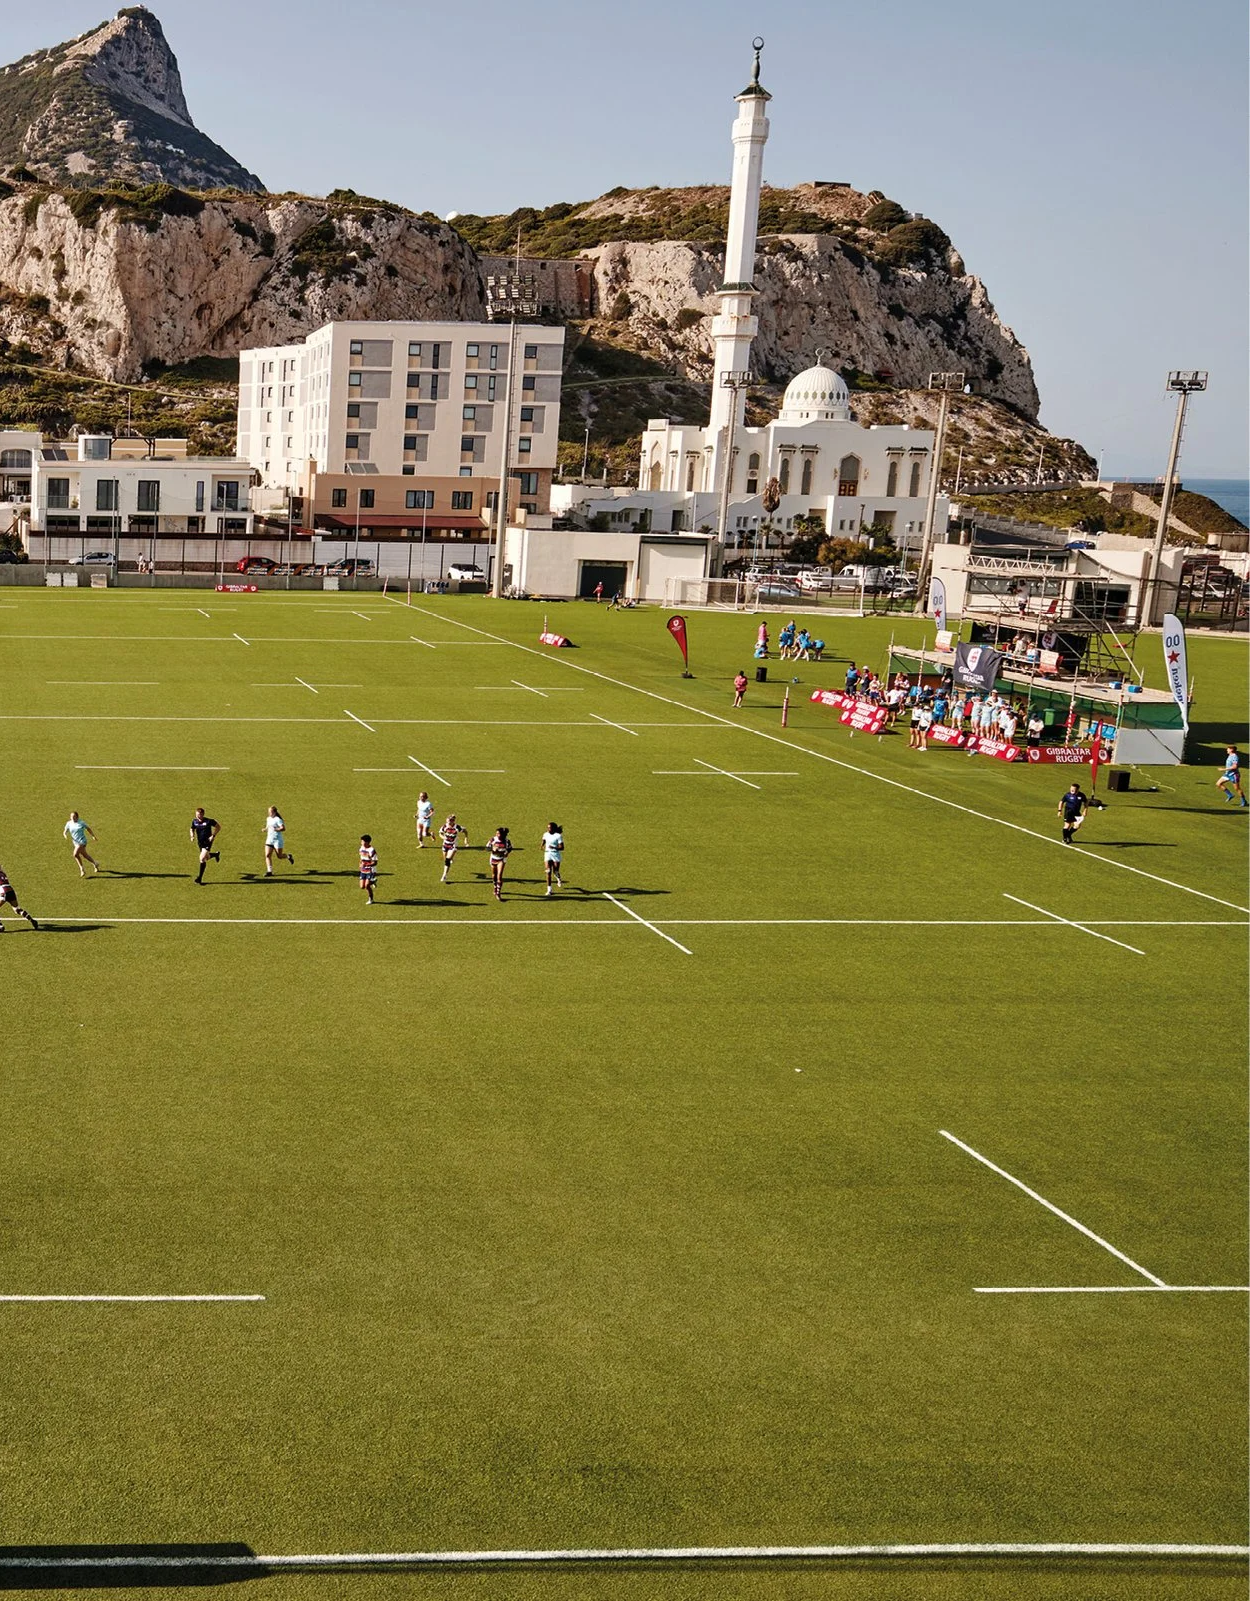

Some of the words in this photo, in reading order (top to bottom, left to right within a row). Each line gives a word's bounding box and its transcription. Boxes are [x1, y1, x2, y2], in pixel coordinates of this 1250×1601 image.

[931, 723, 959, 737] GIBRALTAR
[978, 737, 1007, 751] GIBRALTAR
[1046, 747, 1092, 756] GIBRALTAR
[1055, 755, 1084, 763] RUGBY
